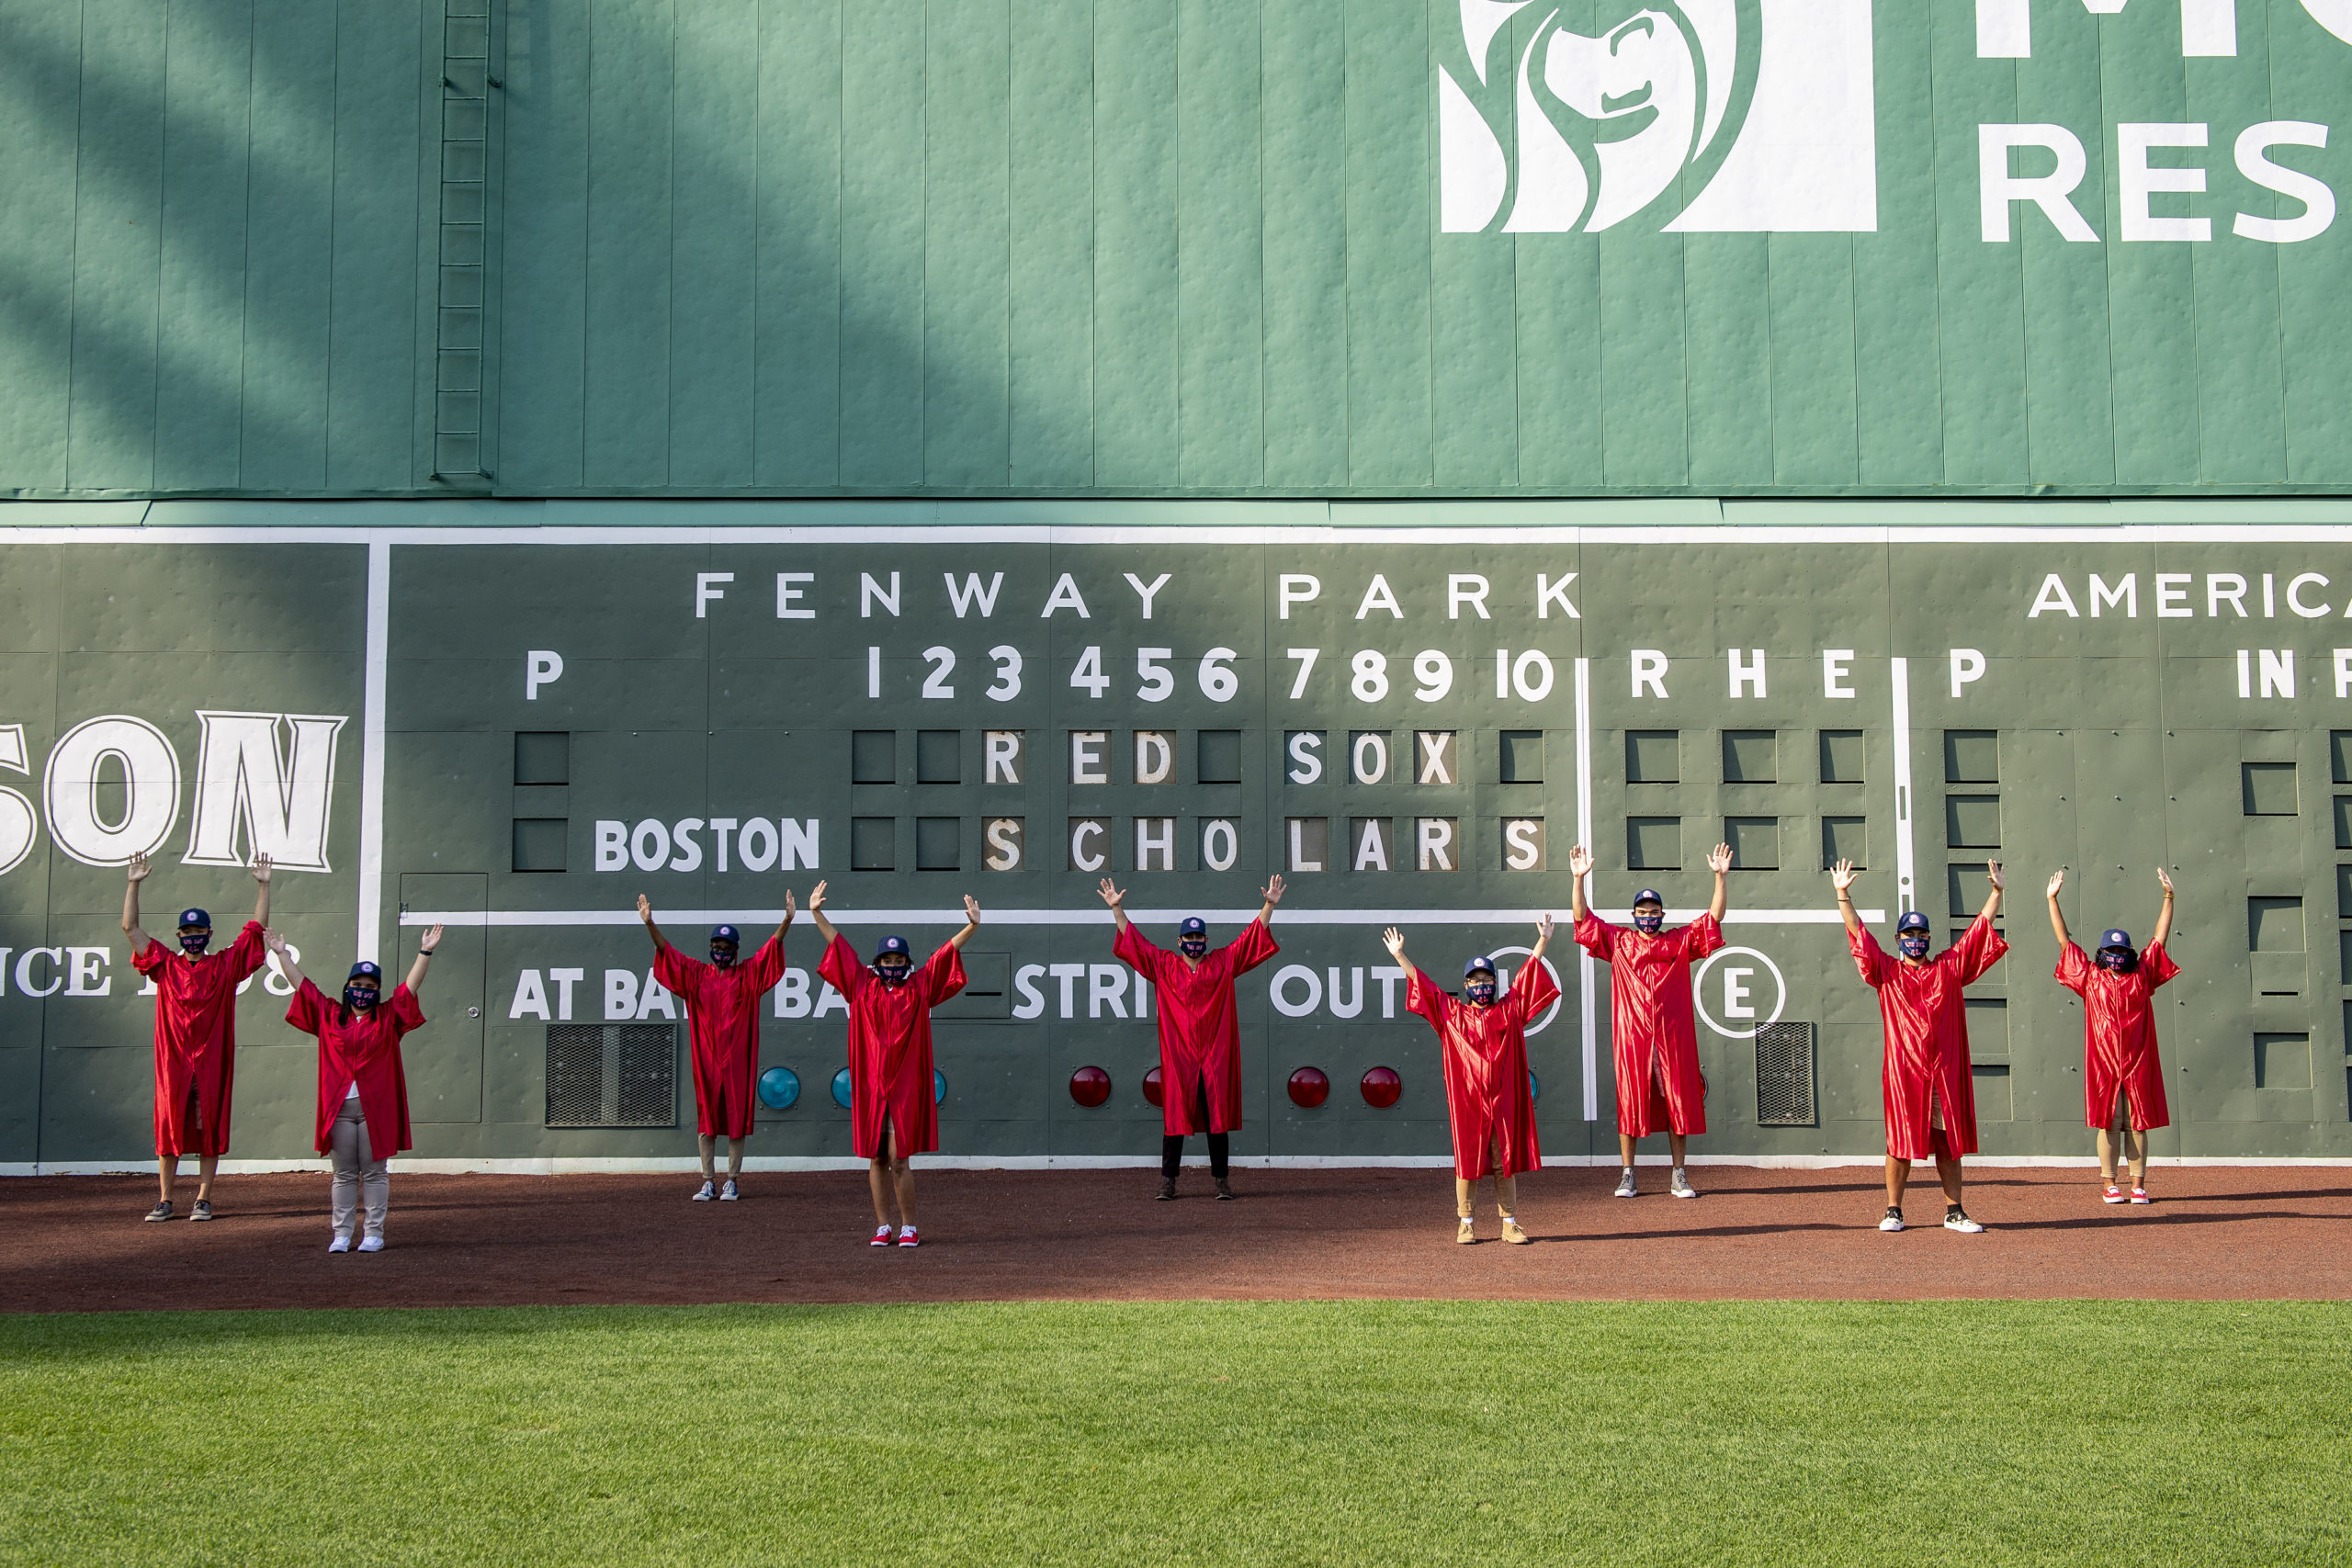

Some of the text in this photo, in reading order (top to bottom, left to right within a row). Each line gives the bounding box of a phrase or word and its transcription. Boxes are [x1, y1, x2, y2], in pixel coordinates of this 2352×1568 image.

[1978, 120, 2337, 243] RES
[695, 570, 1582, 620] FENWAY PARK
[2028, 571, 2352, 619] AMERIC
[526, 645, 1856, 703] P 1 2 3 4 5 6 7 8 9 10 R H E
[1950, 649, 1987, 698] P
[2236, 649, 2295, 699] IN
[986, 730, 1452, 785] RED SOX
[595, 817, 1539, 873] BOSTON SCHOLARS
[0, 946, 111, 998] CE
[509, 966, 689, 1021] AT BA
[1012, 963, 1407, 1020] STRI OUT
[1724, 967, 1756, 1019] E
